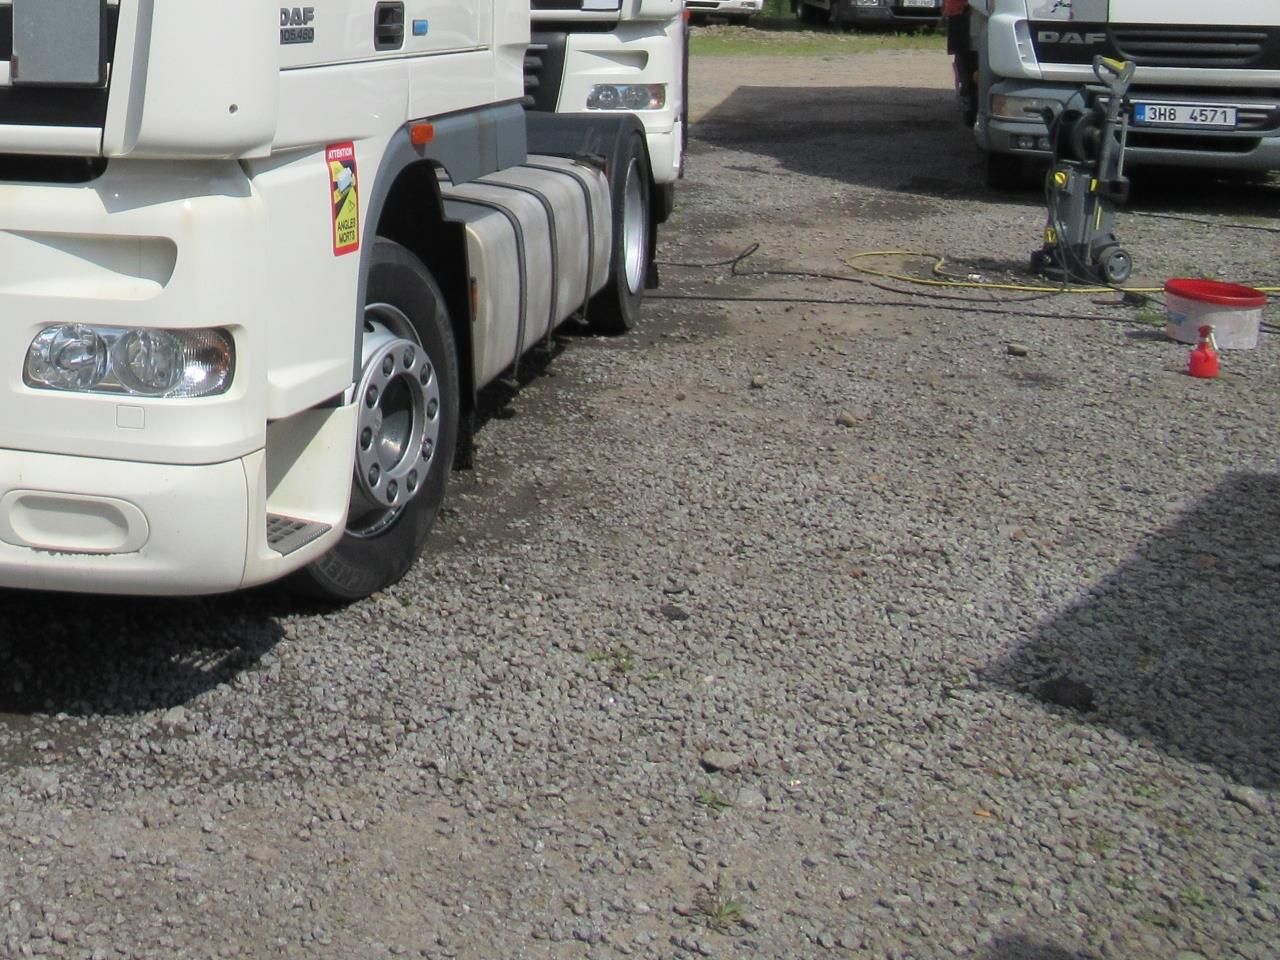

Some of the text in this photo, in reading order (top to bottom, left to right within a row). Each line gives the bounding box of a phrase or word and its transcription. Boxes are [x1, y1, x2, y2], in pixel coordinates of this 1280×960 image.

[280, 7, 315, 26] DAF
[1037, 30, 1107, 45] DAF
[1149, 107, 1228, 123] 3H8 4571
